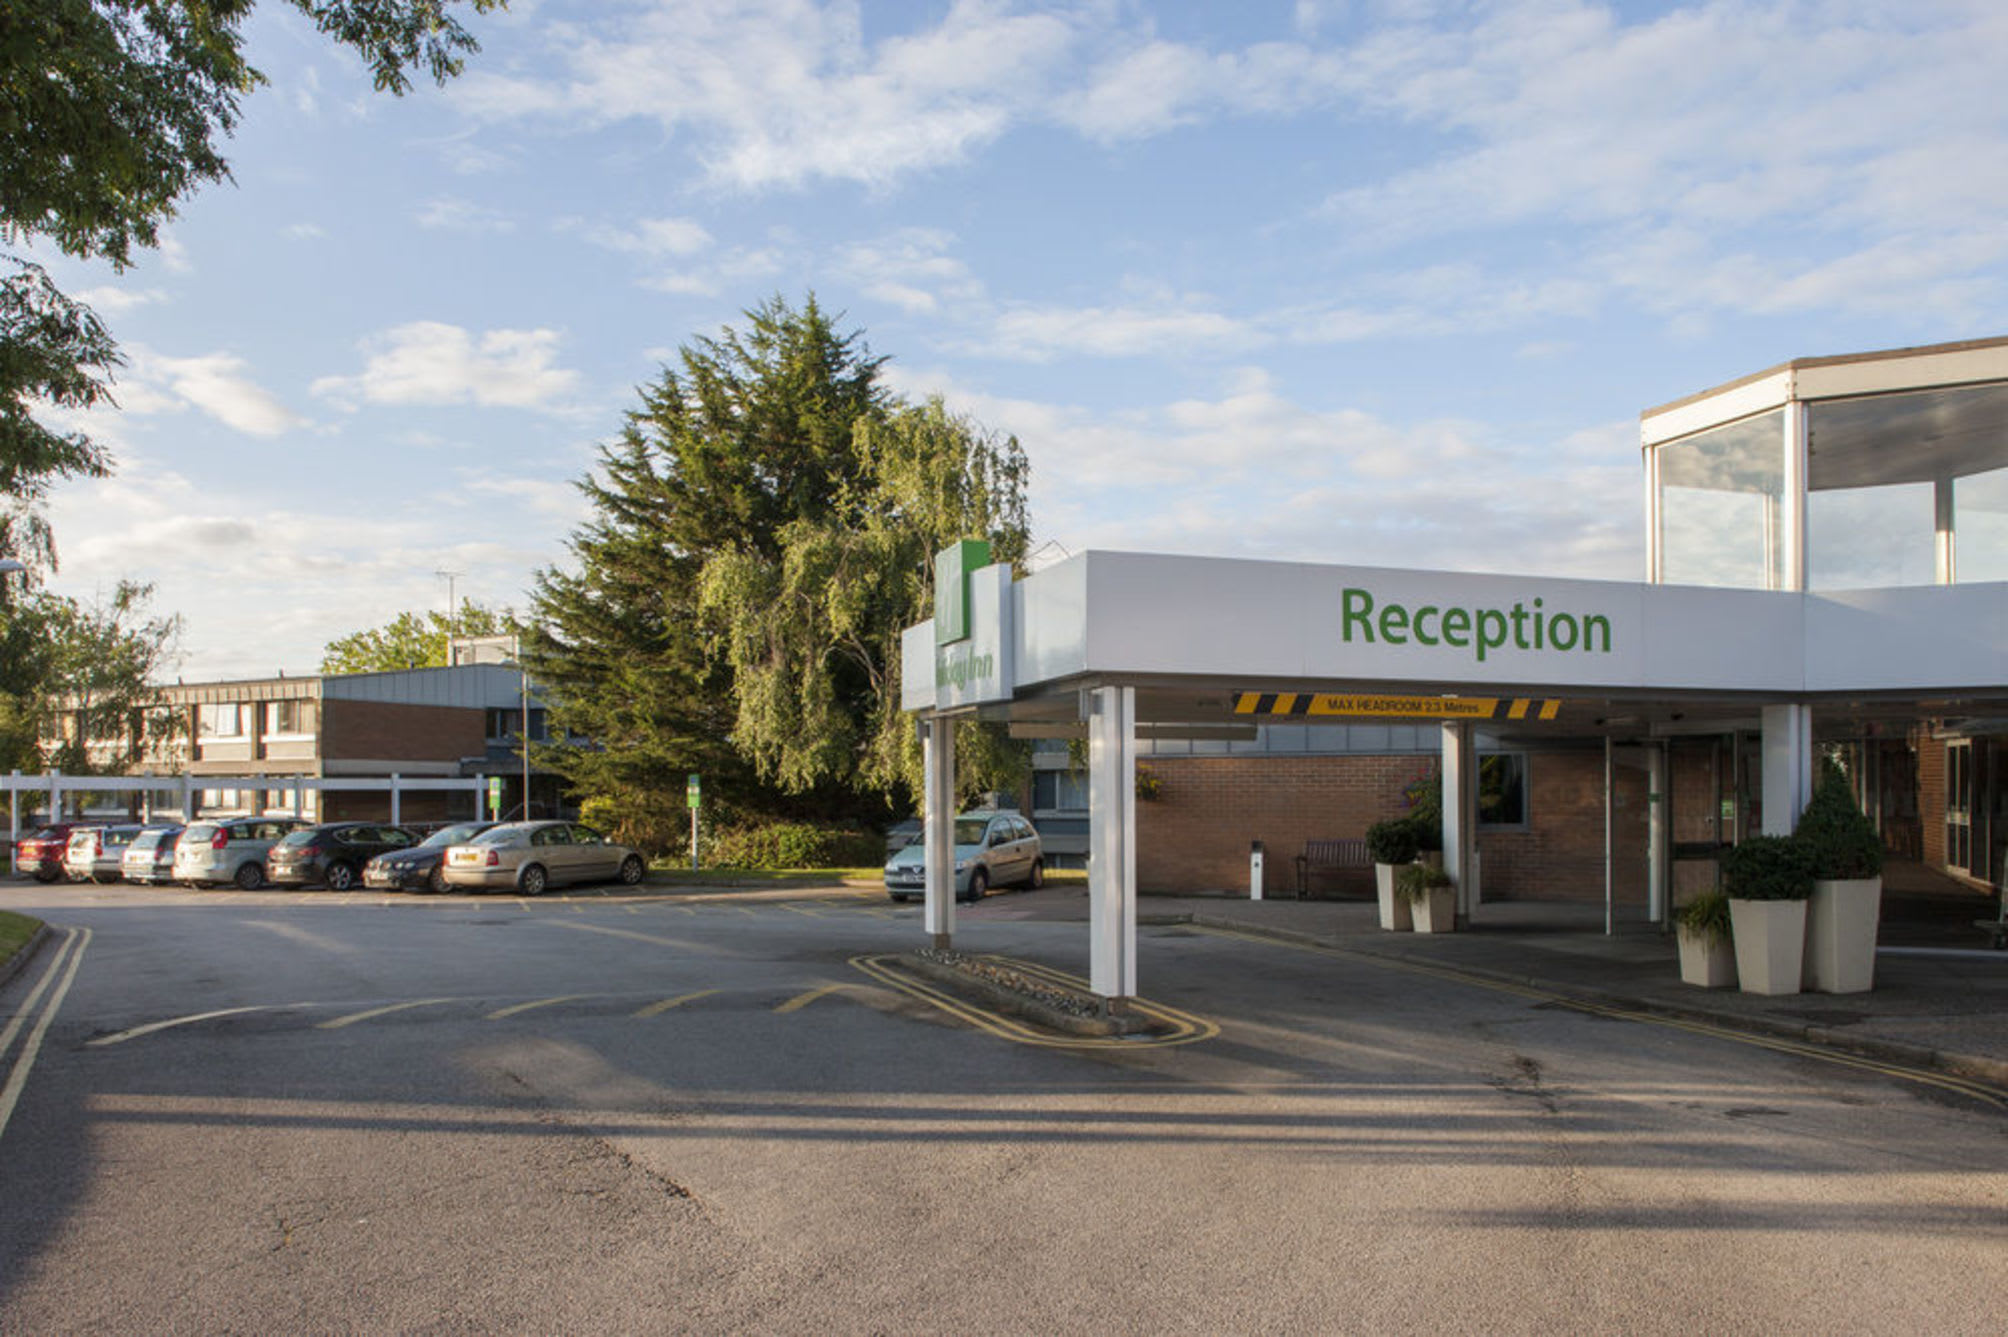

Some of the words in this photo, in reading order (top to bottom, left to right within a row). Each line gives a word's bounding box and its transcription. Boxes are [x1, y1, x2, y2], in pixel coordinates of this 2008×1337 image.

[1341, 588, 1611, 662] Reception
[1327, 698, 1355, 711] MAX
[1356, 699, 1423, 713] HEADROOM
[1444, 702, 1479, 714] Metres
